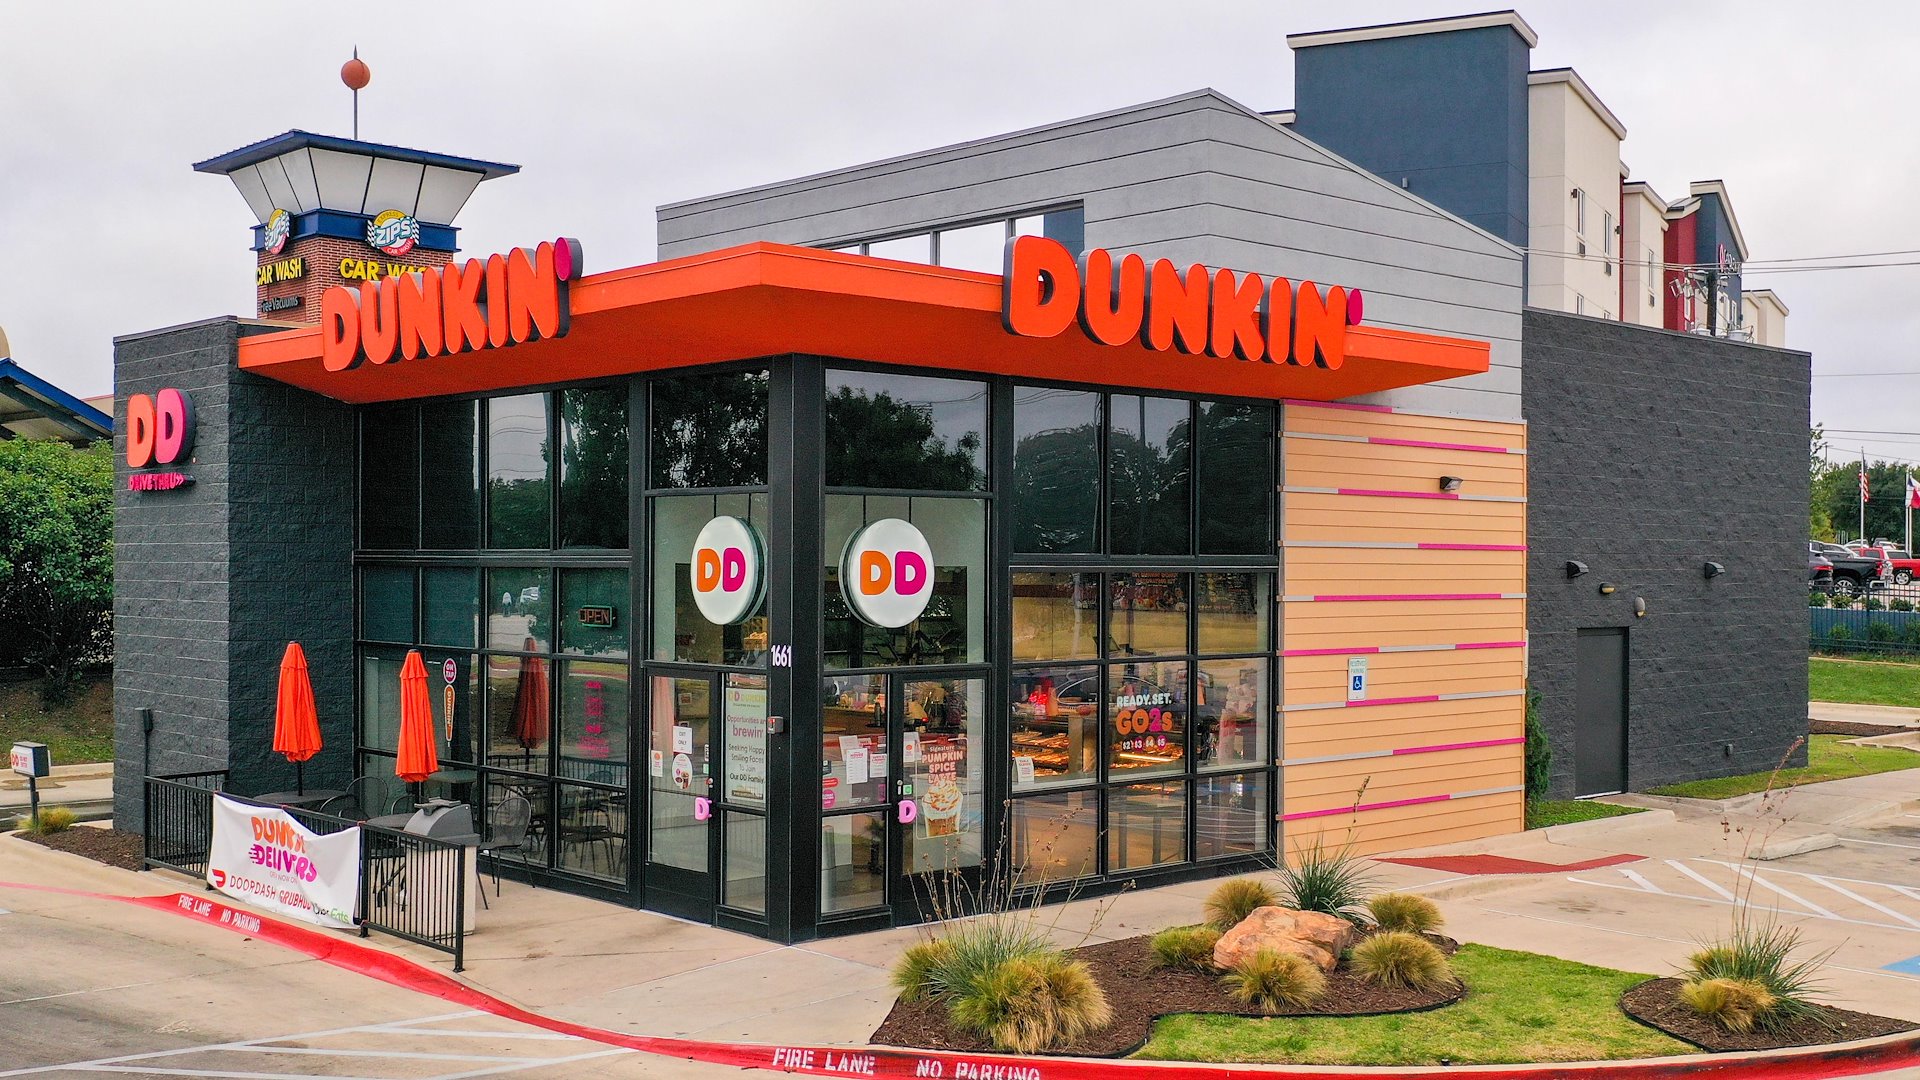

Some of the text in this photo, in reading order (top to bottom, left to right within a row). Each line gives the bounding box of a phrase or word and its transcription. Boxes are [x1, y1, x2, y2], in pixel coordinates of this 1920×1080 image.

[376, 220, 411, 245] ZIPS
[399, 240, 413, 253] WASH
[256, 258, 302, 286] CAR WASH
[340, 258, 379, 281] CAR
[322, 237, 577, 371] DUNKIN'
[1006, 235, 1363, 370] DUNKIN'
[127, 387, 187, 468] DD
[697, 547, 747, 593] DD
[859, 550, 928, 596] DD
[579, 608, 610, 624] OPEN
[771, 645, 792, 667] 1661
[727, 715, 759, 724] Opportunities
[728, 744, 748, 753] Seeking
[922, 750, 964, 764] PUMPKIN
[929, 761, 956, 773] SPICE
[929, 771, 957, 786] LATTE
[229, 875, 276, 900] DOORDASH
[330, 908, 350, 924] Eats
[178, 894, 261, 932] FIRE LANE NO PARKING
[772, 1048, 1041, 1080] FIRE LANE NO PARKING
